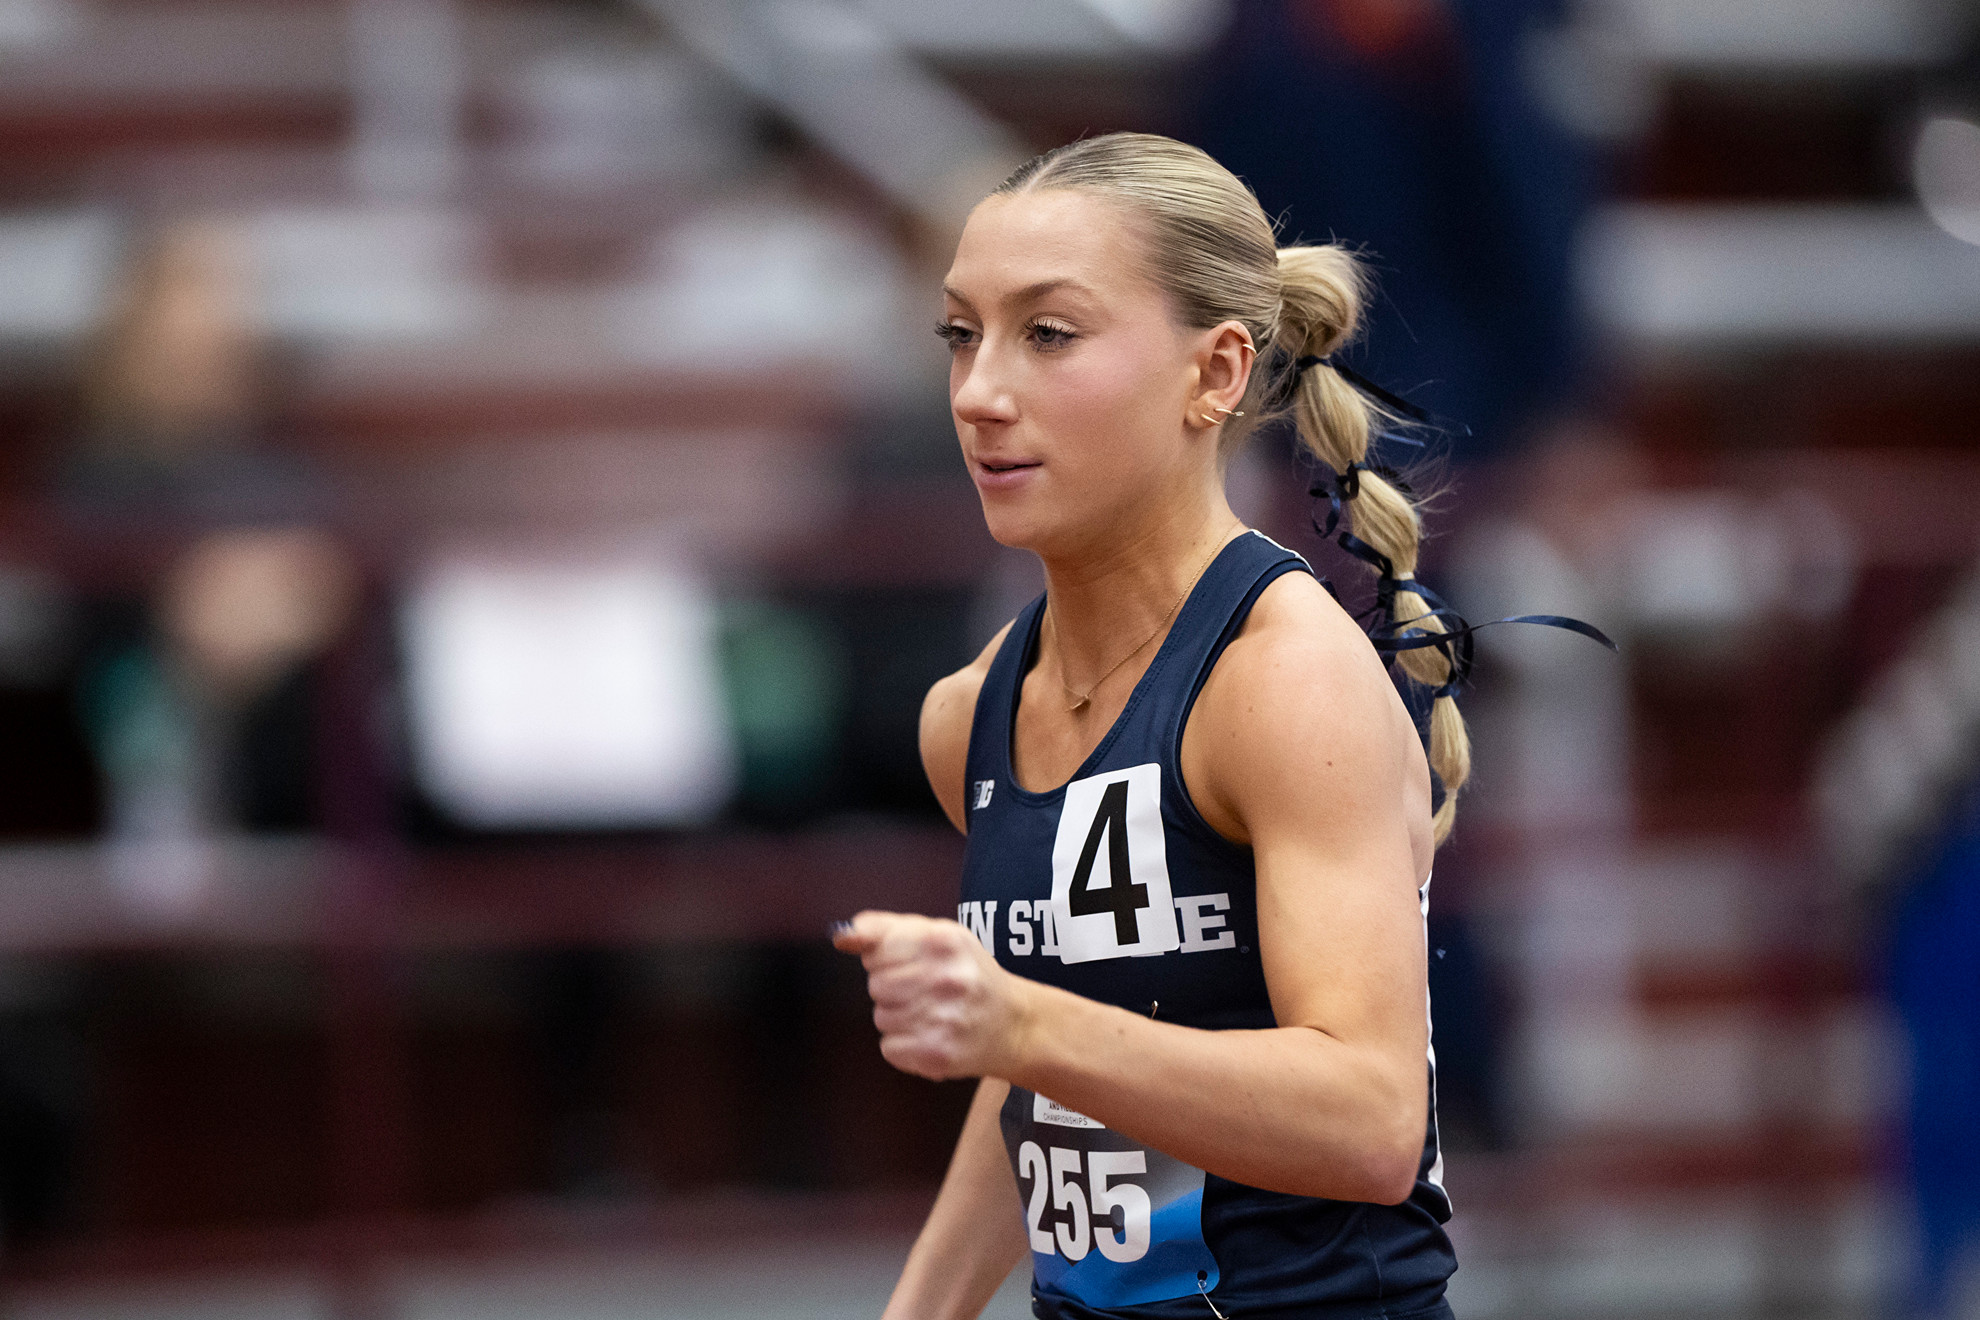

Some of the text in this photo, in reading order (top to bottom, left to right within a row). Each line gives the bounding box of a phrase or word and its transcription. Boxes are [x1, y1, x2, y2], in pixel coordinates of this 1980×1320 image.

[1069, 780, 1150, 946] 4
[1008, 893, 1236, 957] STE
[1043, 1113, 1088, 1126] CHAMPIONSHIPS
[1019, 1141, 1151, 1263] 255
